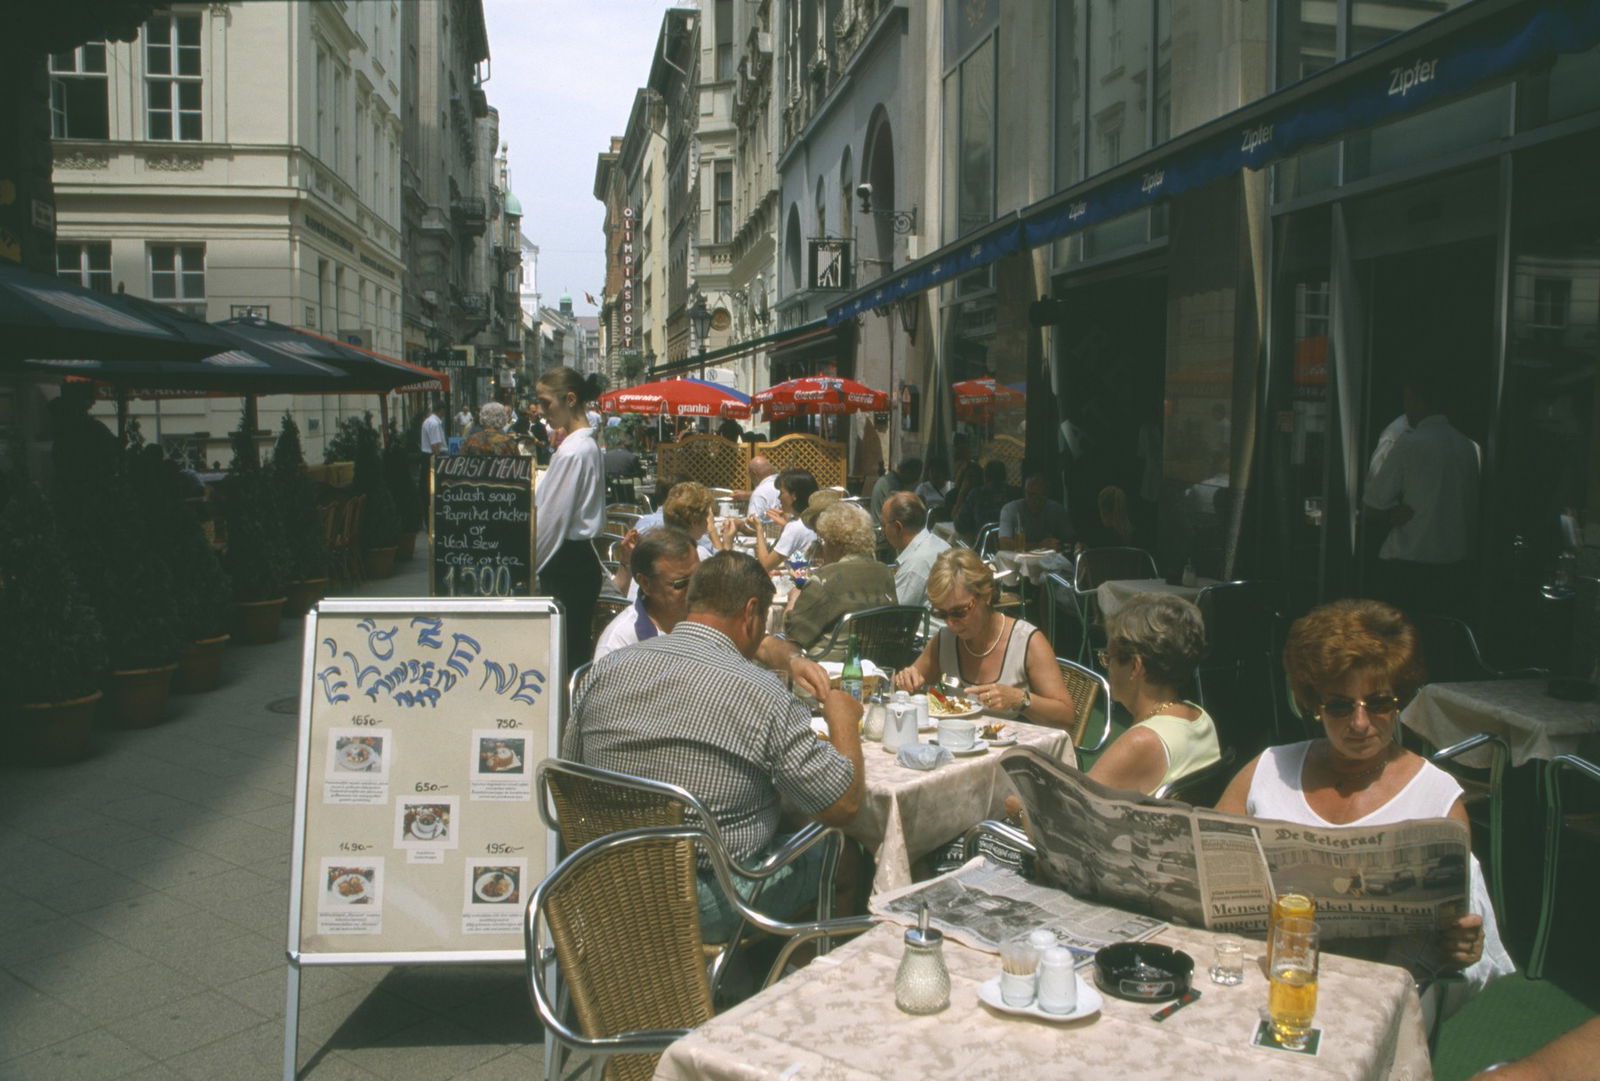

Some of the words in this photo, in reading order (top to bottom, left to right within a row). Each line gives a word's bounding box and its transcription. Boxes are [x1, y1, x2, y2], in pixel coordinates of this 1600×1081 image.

[1387, 58, 1439, 96] Zipfer
[1241, 124, 1274, 153] Zipfer
[677, 402, 710, 415] granini
[489, 492, 517, 506] soup
[469, 525, 486, 536] or
[495, 551, 525, 566] tea
[1275, 828, 1299, 841] De
[1303, 830, 1386, 848] Telegraaf
[1360, 903, 1383, 913] via
[1390, 904, 1434, 915] Iran
